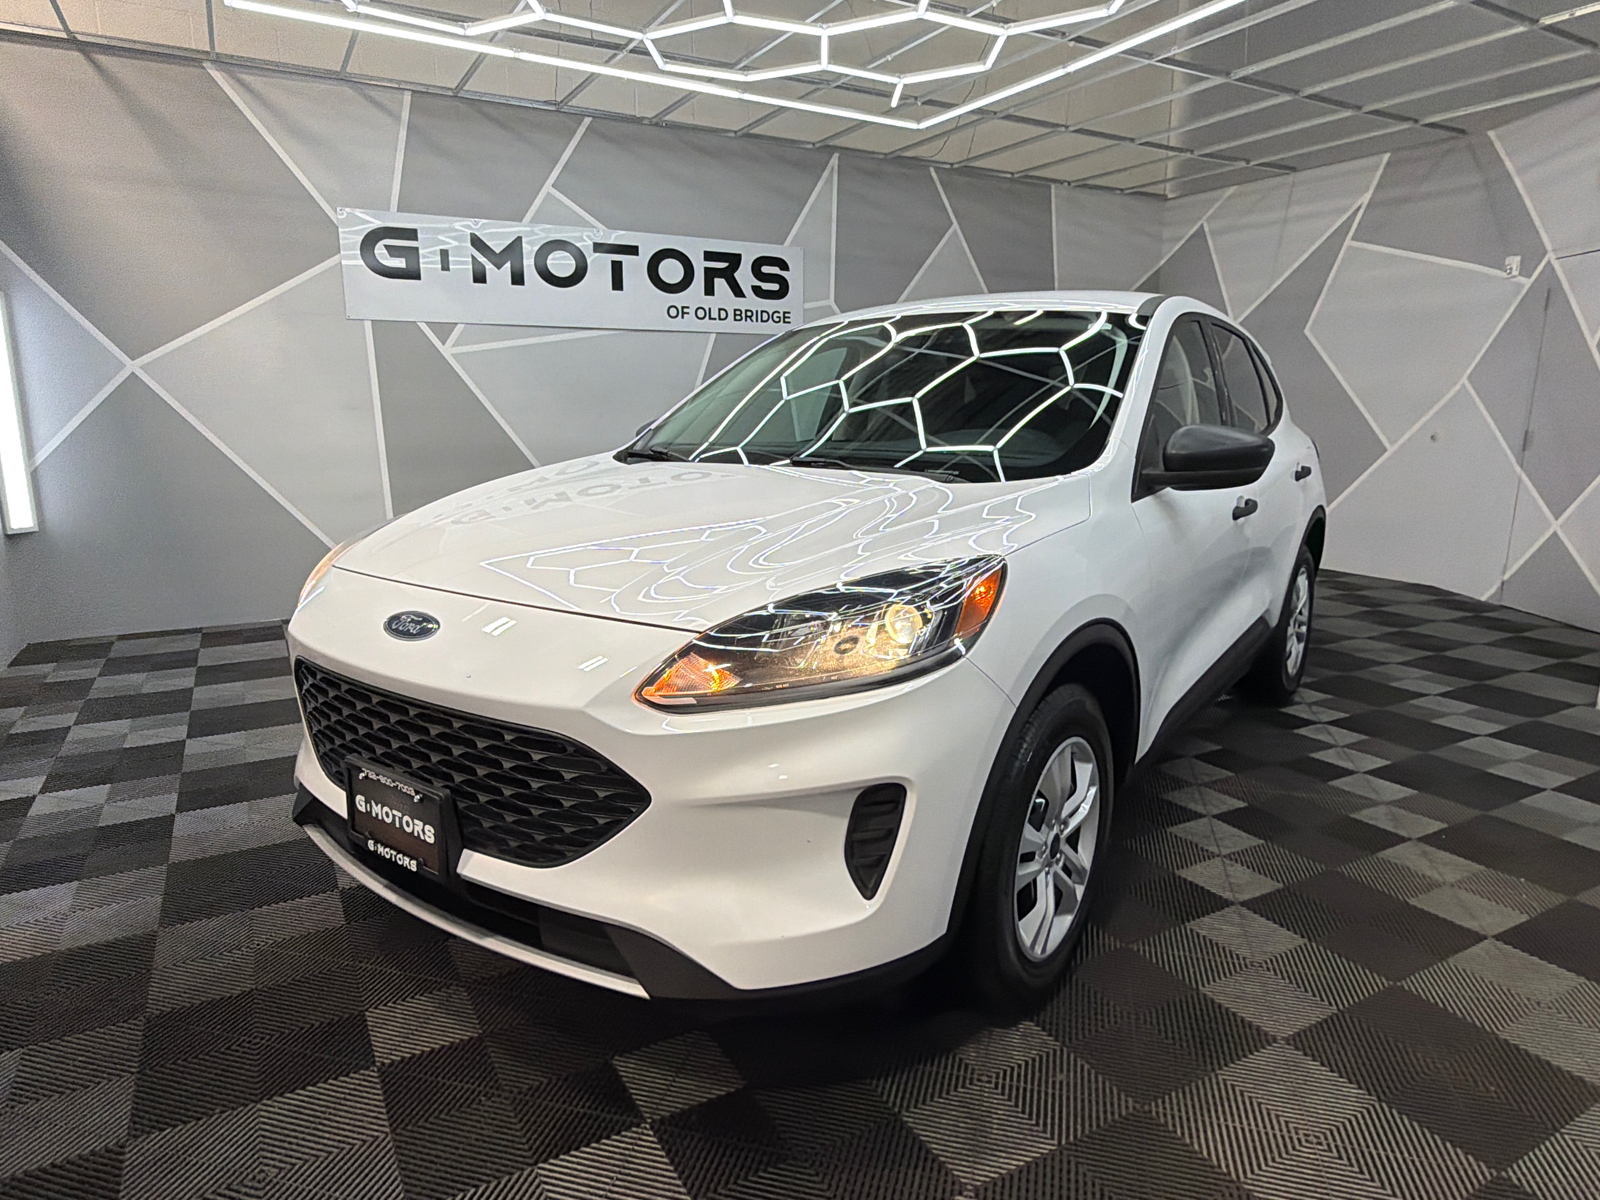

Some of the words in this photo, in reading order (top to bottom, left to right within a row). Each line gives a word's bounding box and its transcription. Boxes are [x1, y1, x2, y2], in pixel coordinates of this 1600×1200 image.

[666, 304, 690, 319] OF
[694, 306, 729, 321] OLD
[733, 308, 792, 324] BRIDGE
[391, 614, 427, 634] Ford
